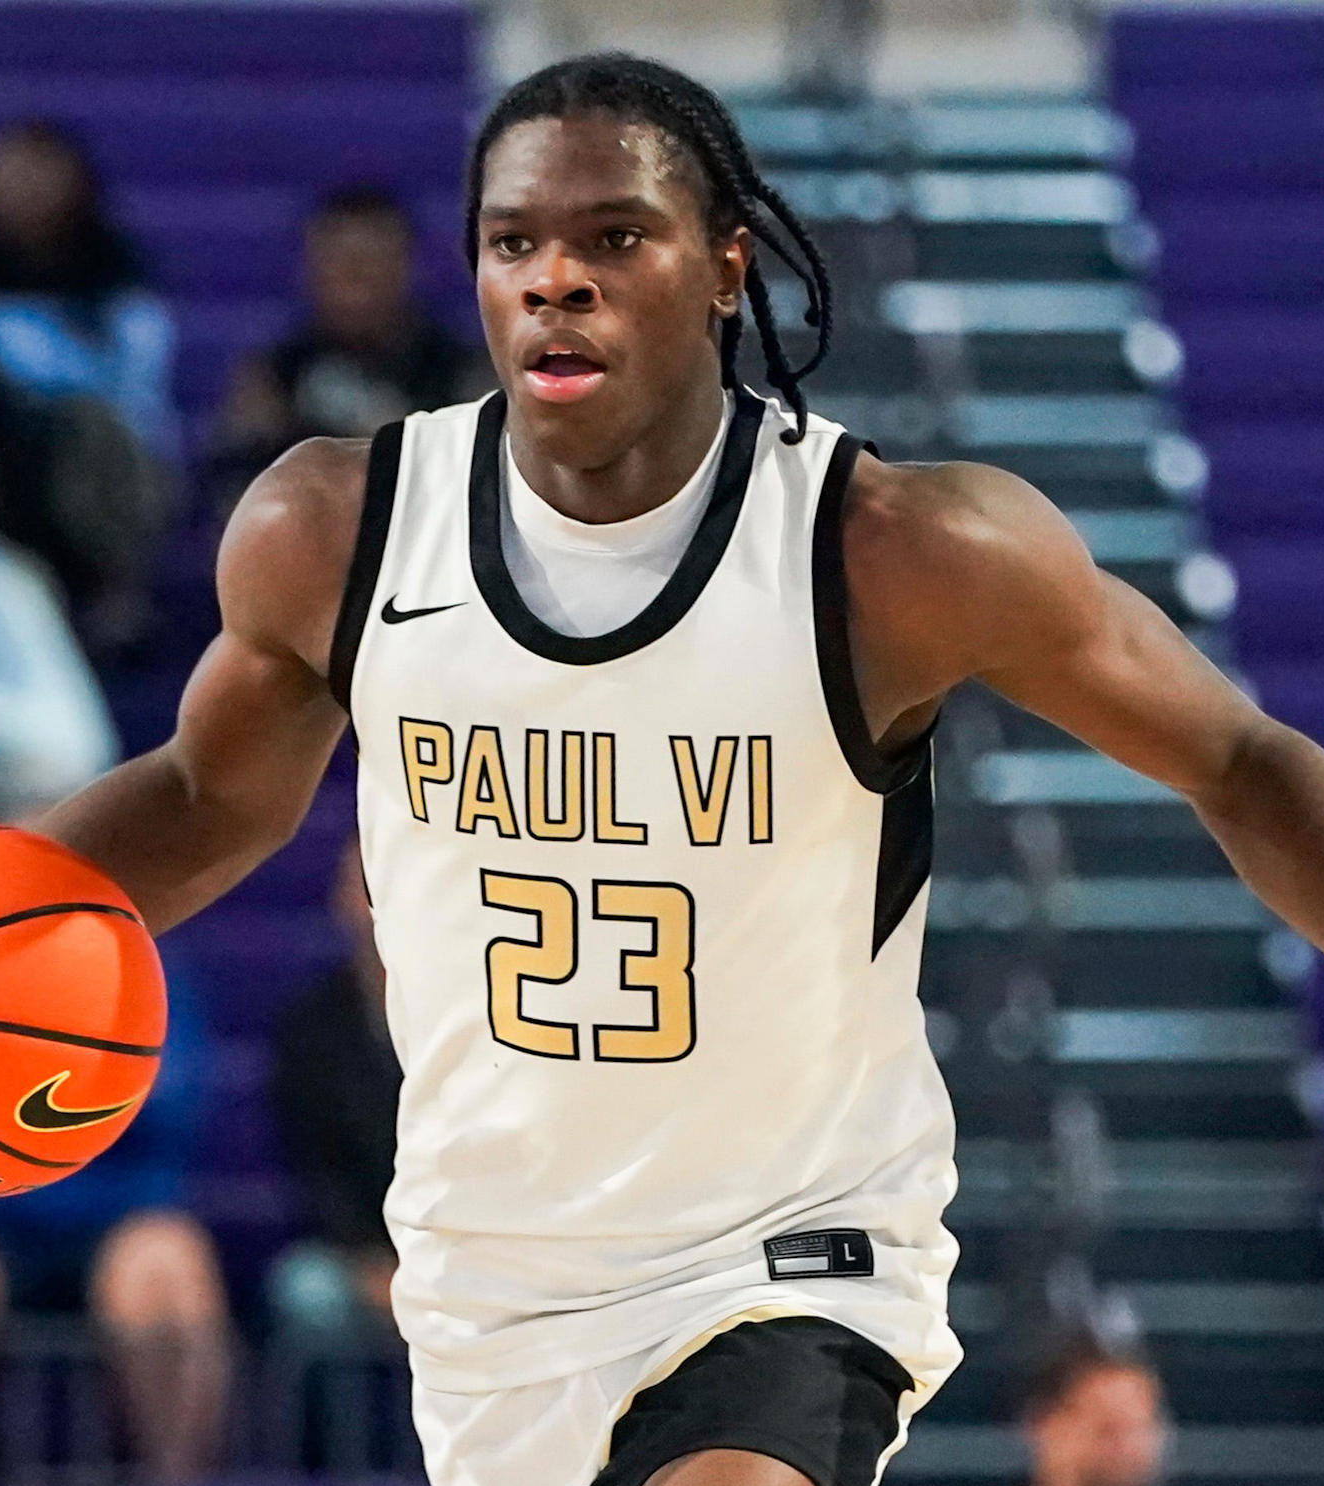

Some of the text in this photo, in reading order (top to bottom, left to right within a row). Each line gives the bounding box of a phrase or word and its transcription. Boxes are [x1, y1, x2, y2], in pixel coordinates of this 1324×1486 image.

[398, 716, 772, 847] PAUL VI
[480, 868, 696, 1063] 23
[843, 1243, 856, 1261] L
